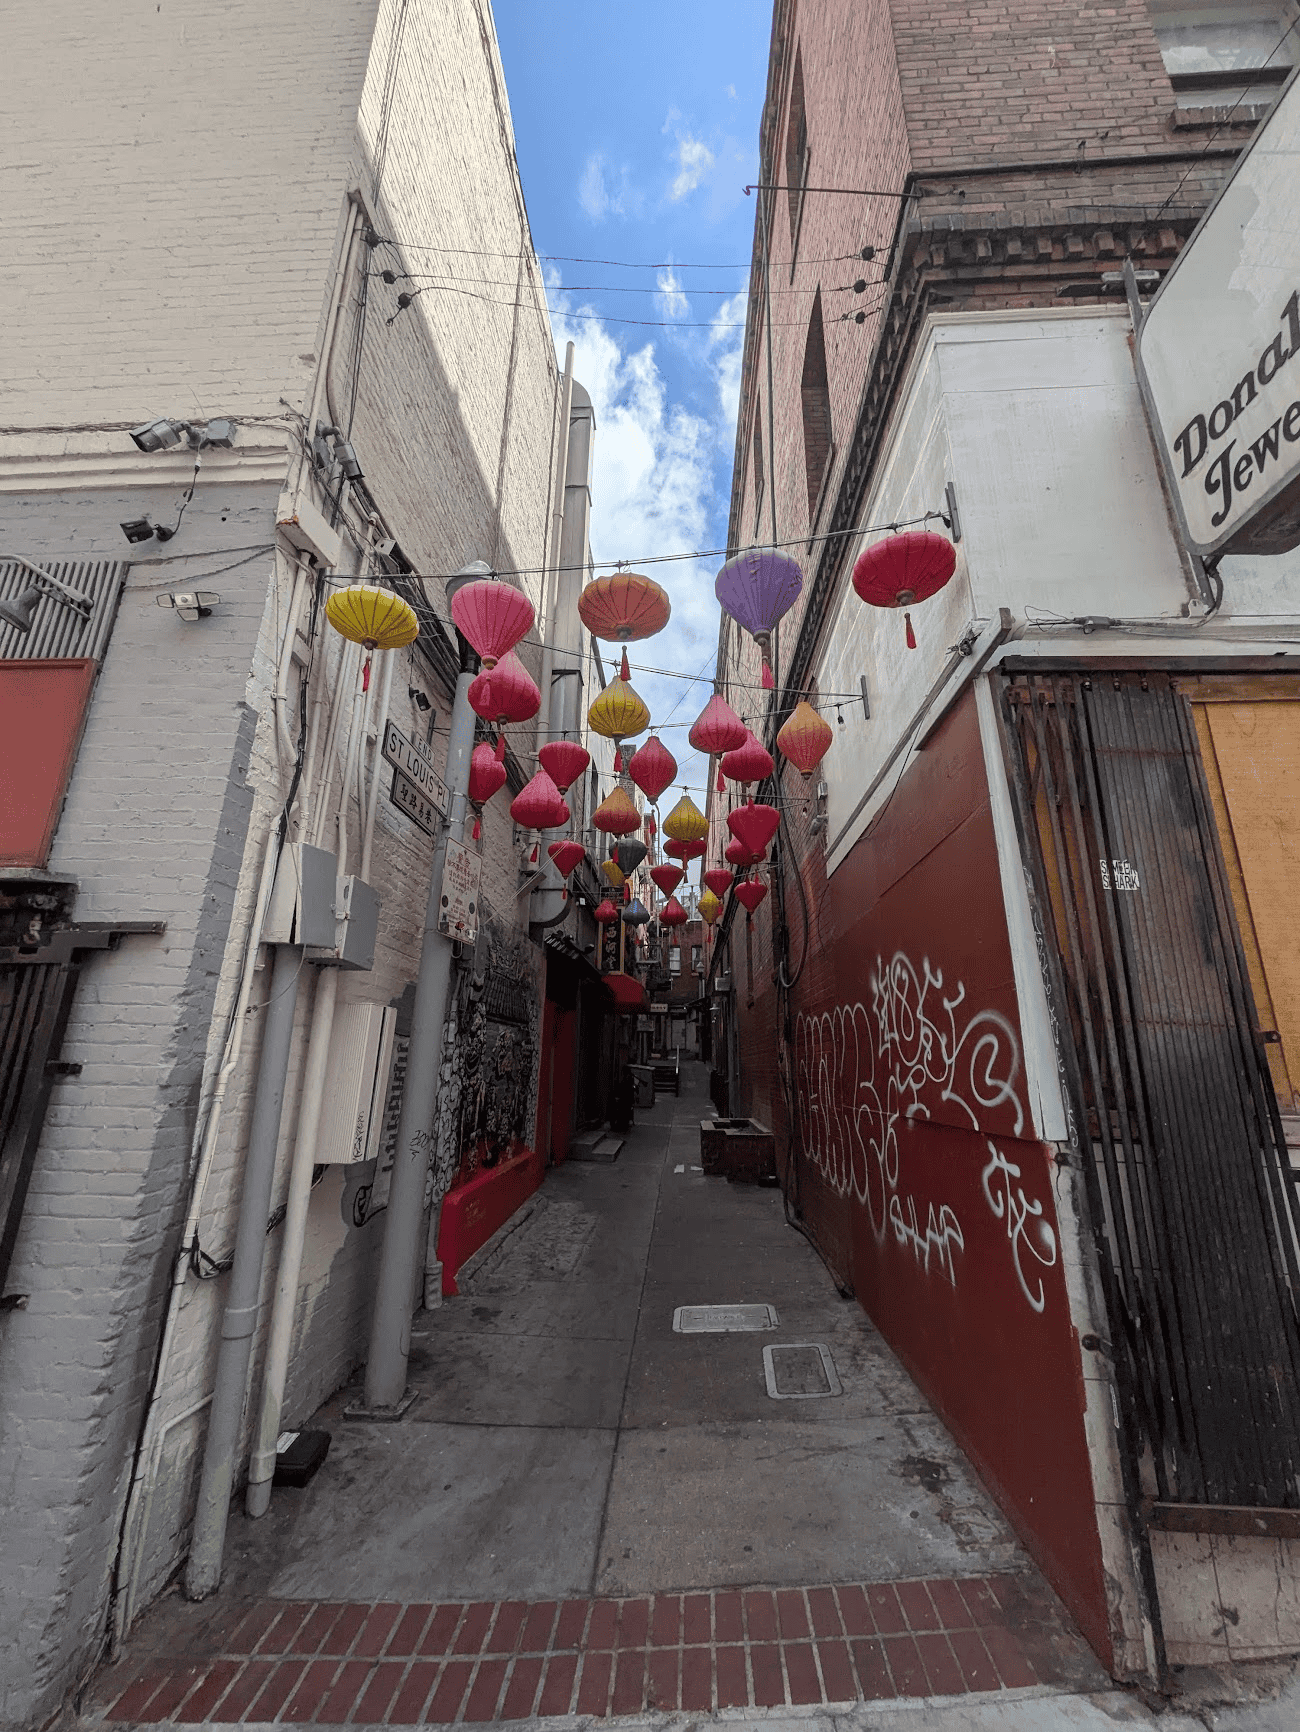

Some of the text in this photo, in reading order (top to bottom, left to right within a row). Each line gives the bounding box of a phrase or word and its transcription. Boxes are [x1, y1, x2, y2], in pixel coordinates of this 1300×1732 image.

[1173, 289, 1300, 479] Donal
[1204, 400, 1300, 528] Jewe
[389, 732, 446, 809] ST LOUIS PL
[417, 738, 432, 761] END
